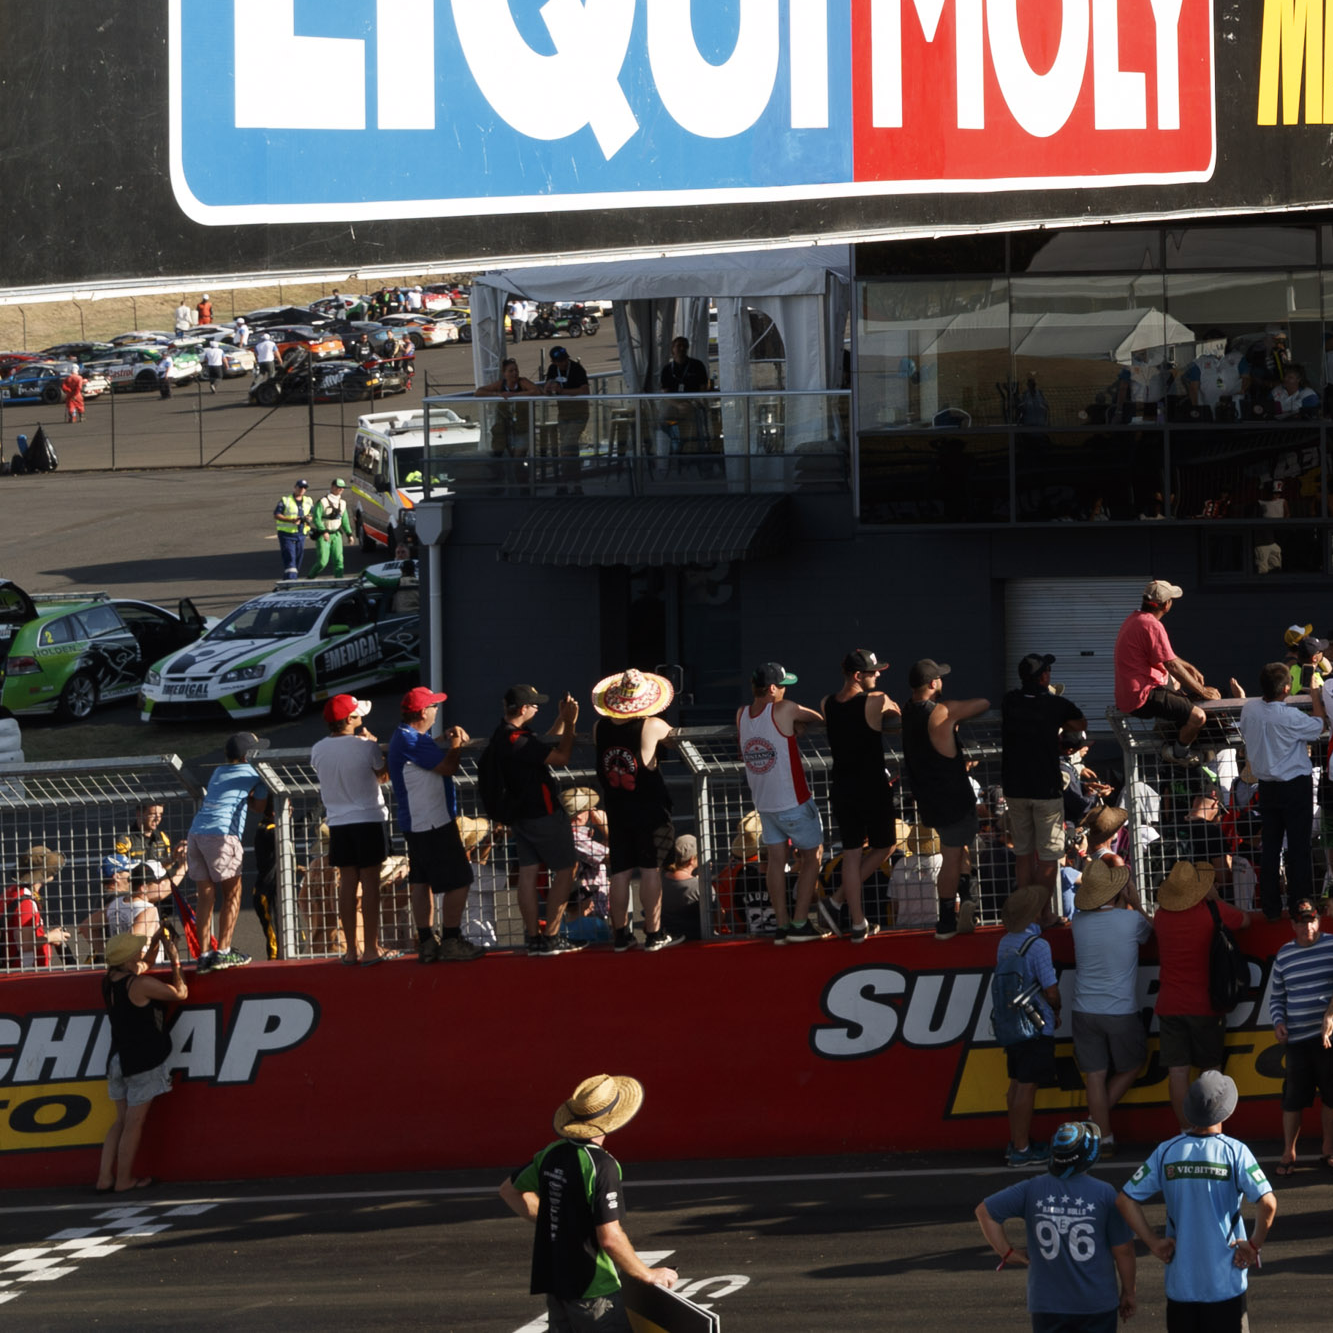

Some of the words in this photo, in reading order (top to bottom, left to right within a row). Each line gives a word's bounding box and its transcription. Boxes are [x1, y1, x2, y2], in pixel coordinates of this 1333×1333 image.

[44, 630, 54, 644] 2
[32, 644, 77, 658] HOLDEN
[329, 632, 380, 670] MEDICAL
[1177, 1165, 1193, 1174] VIC
[1194, 1165, 1229, 1177] BITTER
[1035, 1220, 1096, 1262] 96
